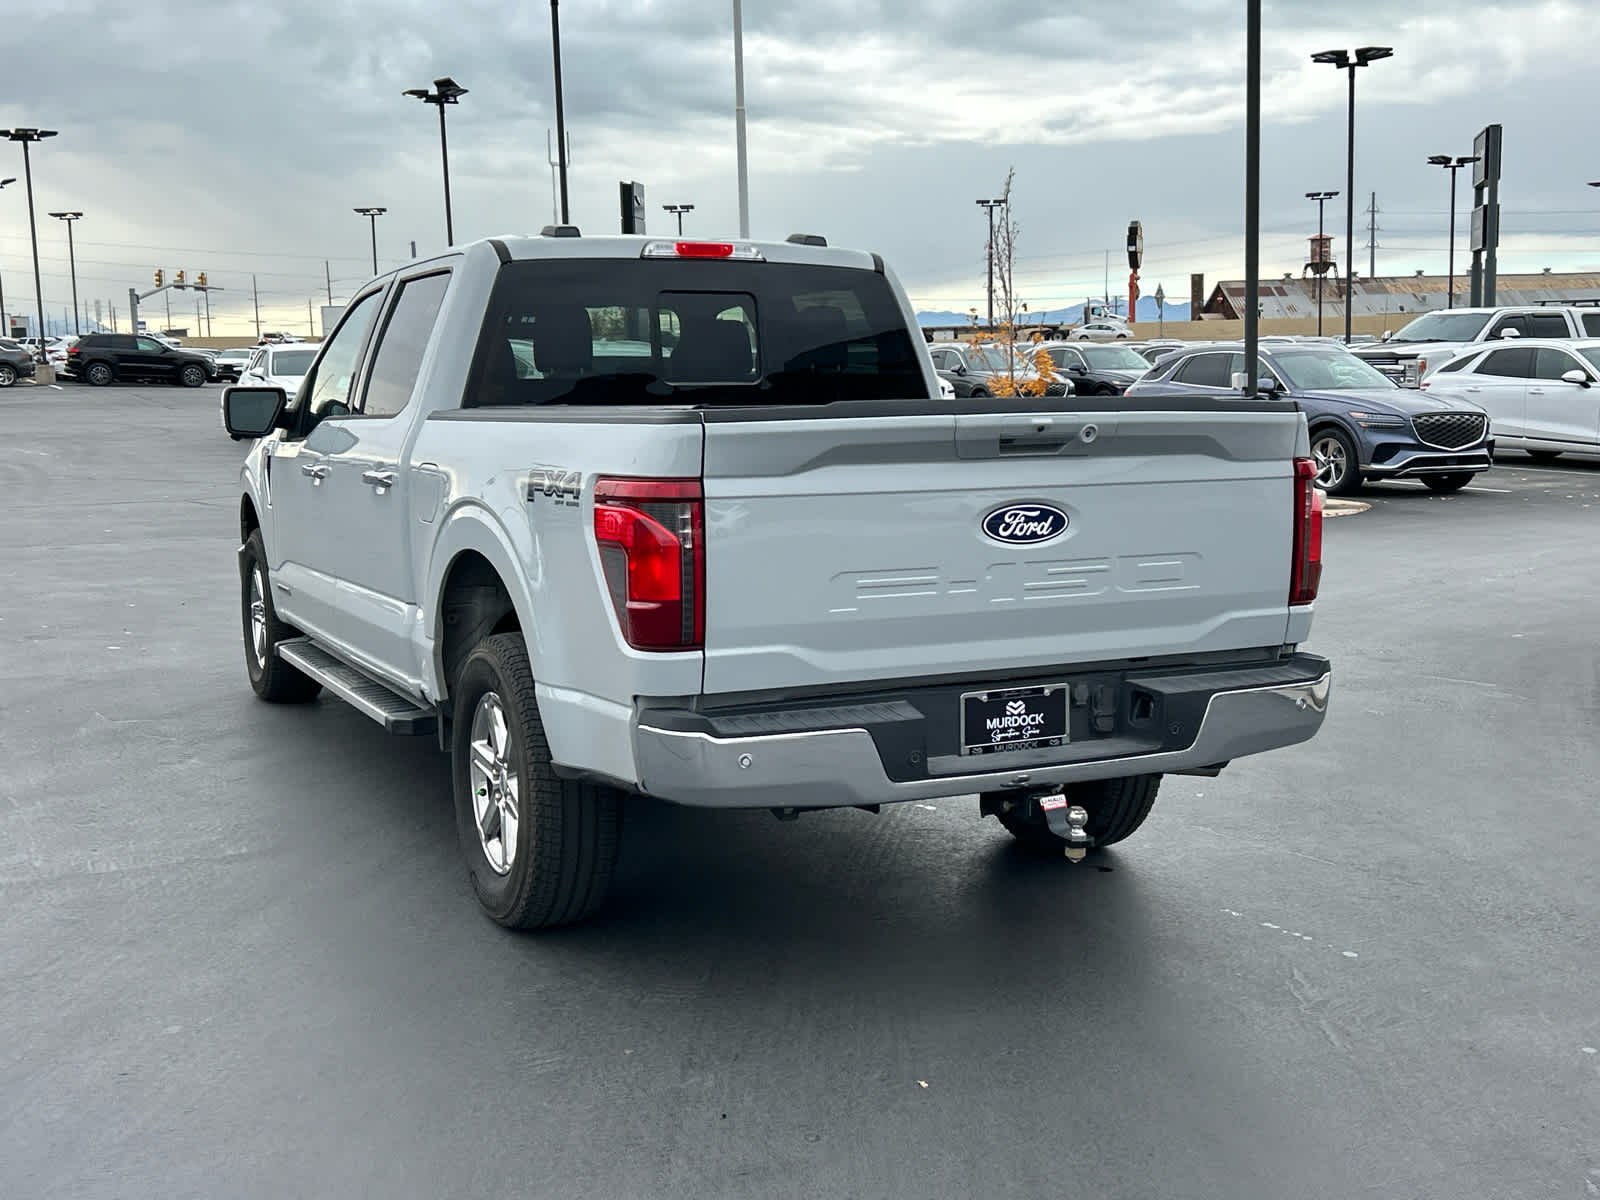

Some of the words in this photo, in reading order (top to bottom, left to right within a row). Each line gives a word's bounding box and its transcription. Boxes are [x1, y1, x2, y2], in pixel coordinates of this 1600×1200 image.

[527, 469, 582, 502] FX4
[999, 510, 1053, 536] Ford
[829, 552, 1202, 614] F-150
[986, 713, 1044, 730] MURDOCK
[994, 741, 1038, 752] MURDOCK
